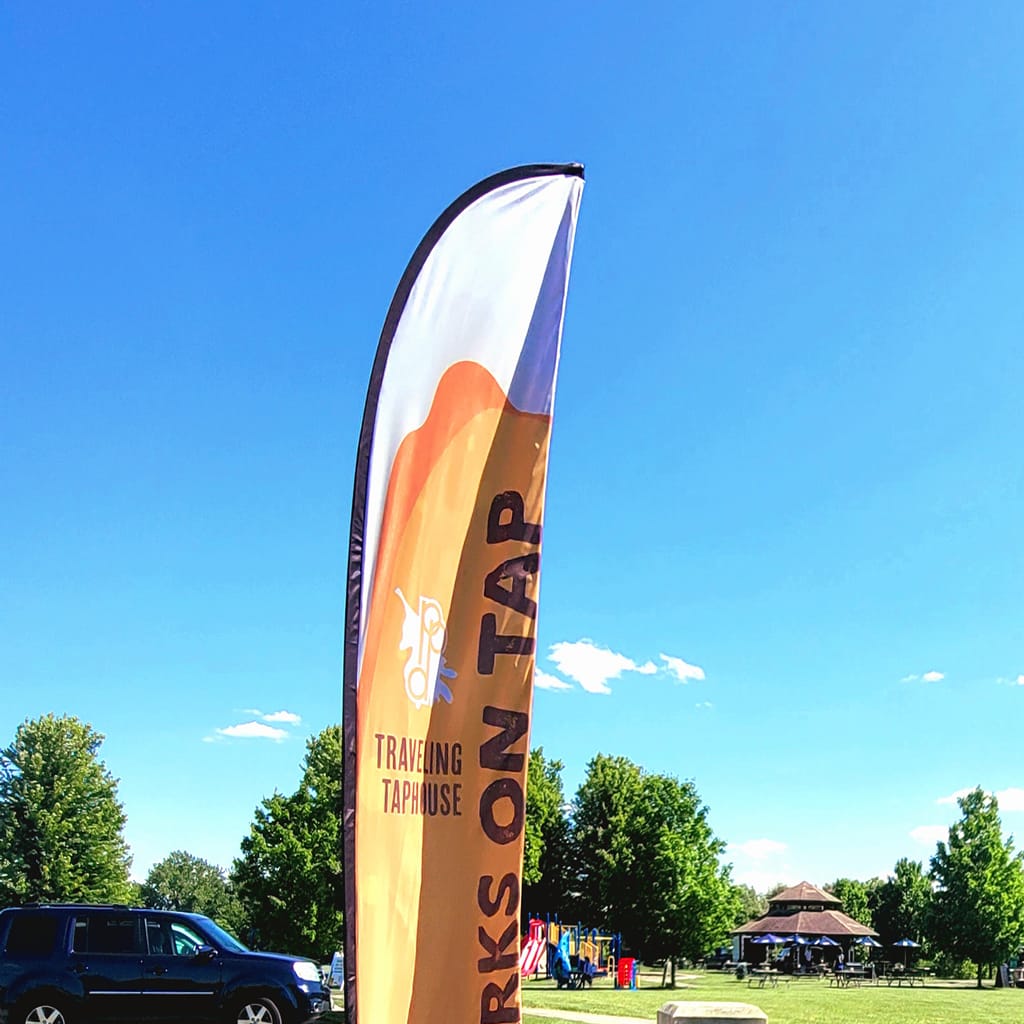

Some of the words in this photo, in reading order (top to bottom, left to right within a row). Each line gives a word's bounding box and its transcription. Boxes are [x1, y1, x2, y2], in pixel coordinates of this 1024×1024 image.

[476, 489, 545, 676] TAP
[375, 733, 463, 776] TRAVELING
[382, 778, 463, 817] TAPHOUSE
[478, 705, 529, 845] ON
